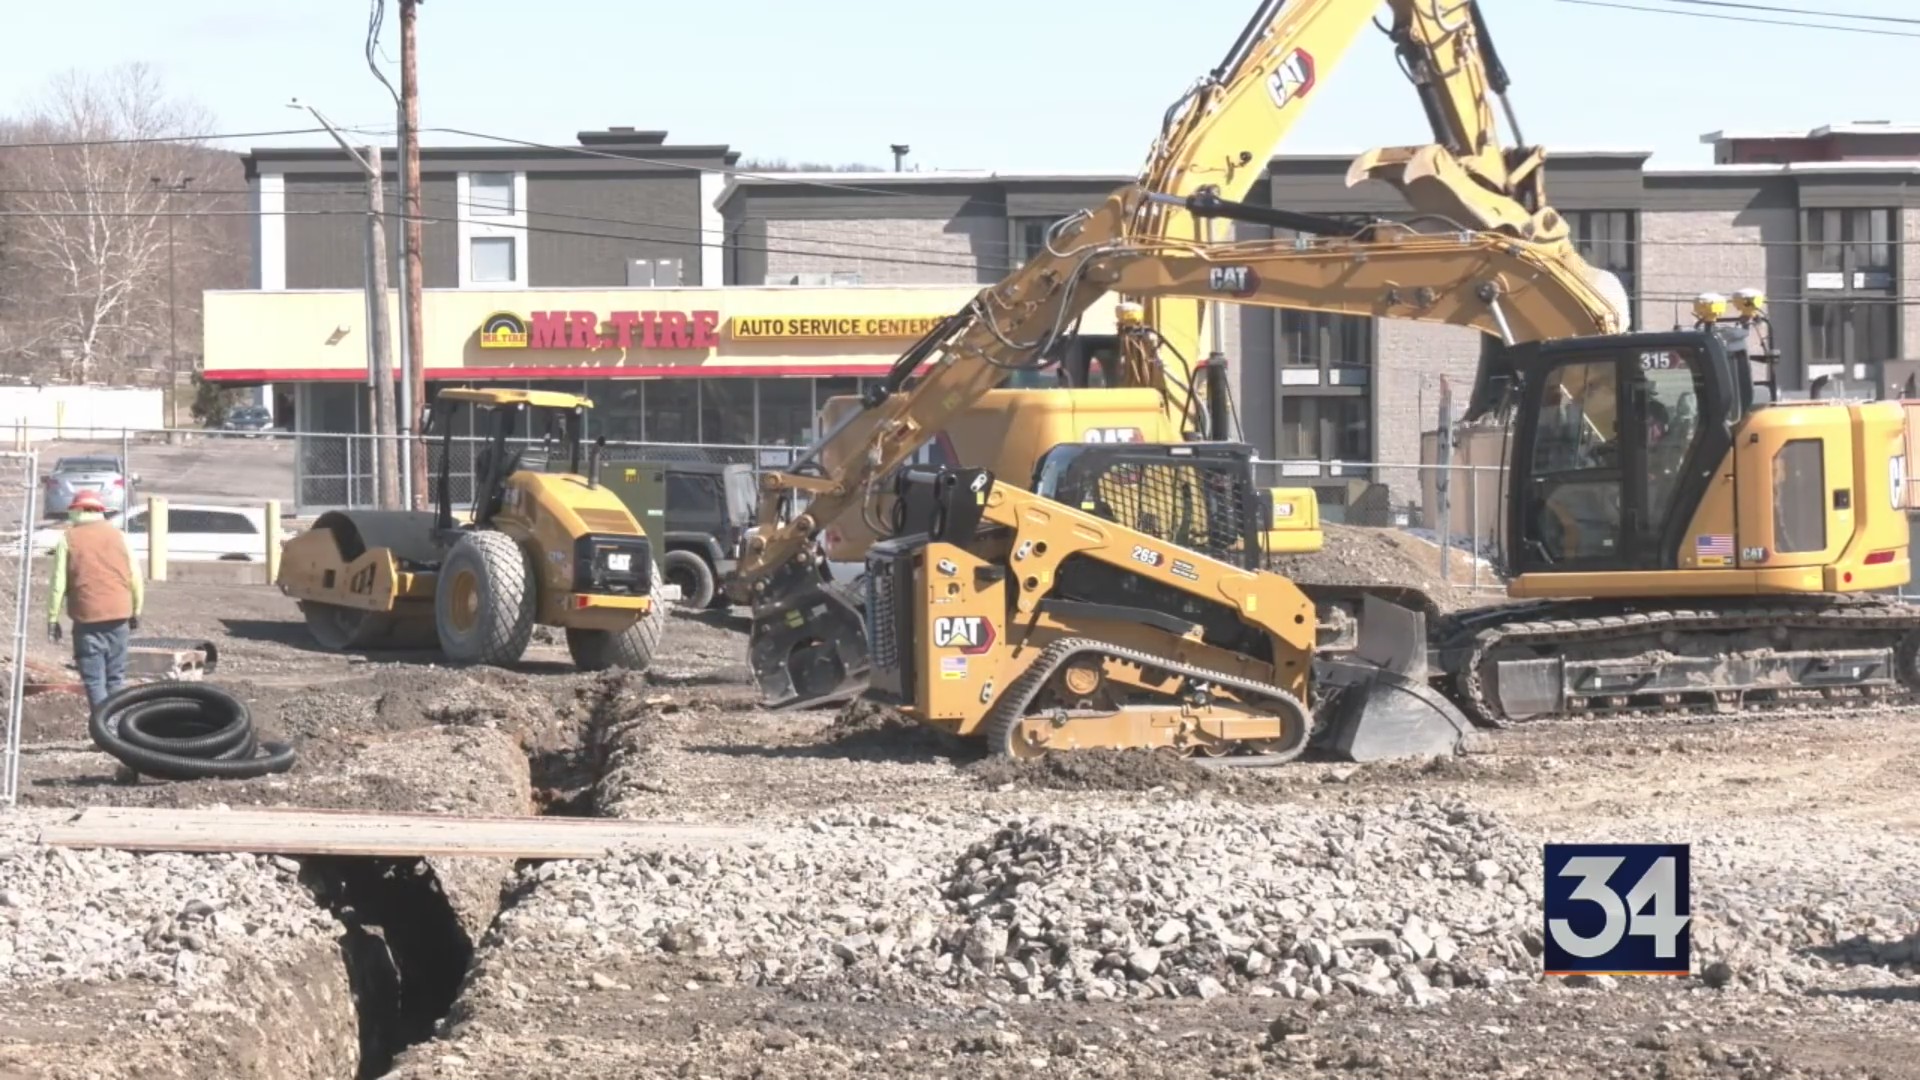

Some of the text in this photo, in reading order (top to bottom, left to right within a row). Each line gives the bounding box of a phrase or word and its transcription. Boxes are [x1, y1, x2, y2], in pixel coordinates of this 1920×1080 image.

[1267, 51, 1305, 107] CAT
[1210, 266, 1248, 290] CAT
[611, 311, 720, 348] TIRE
[739, 318, 784, 336] AUTO
[788, 318, 862, 336] SERVICE
[1641, 352, 1670, 369] 315
[608, 553, 631, 570] CAT
[1132, 545, 1158, 566] 265
[1743, 547, 1764, 560] CAT
[935, 617, 981, 647] CAT
